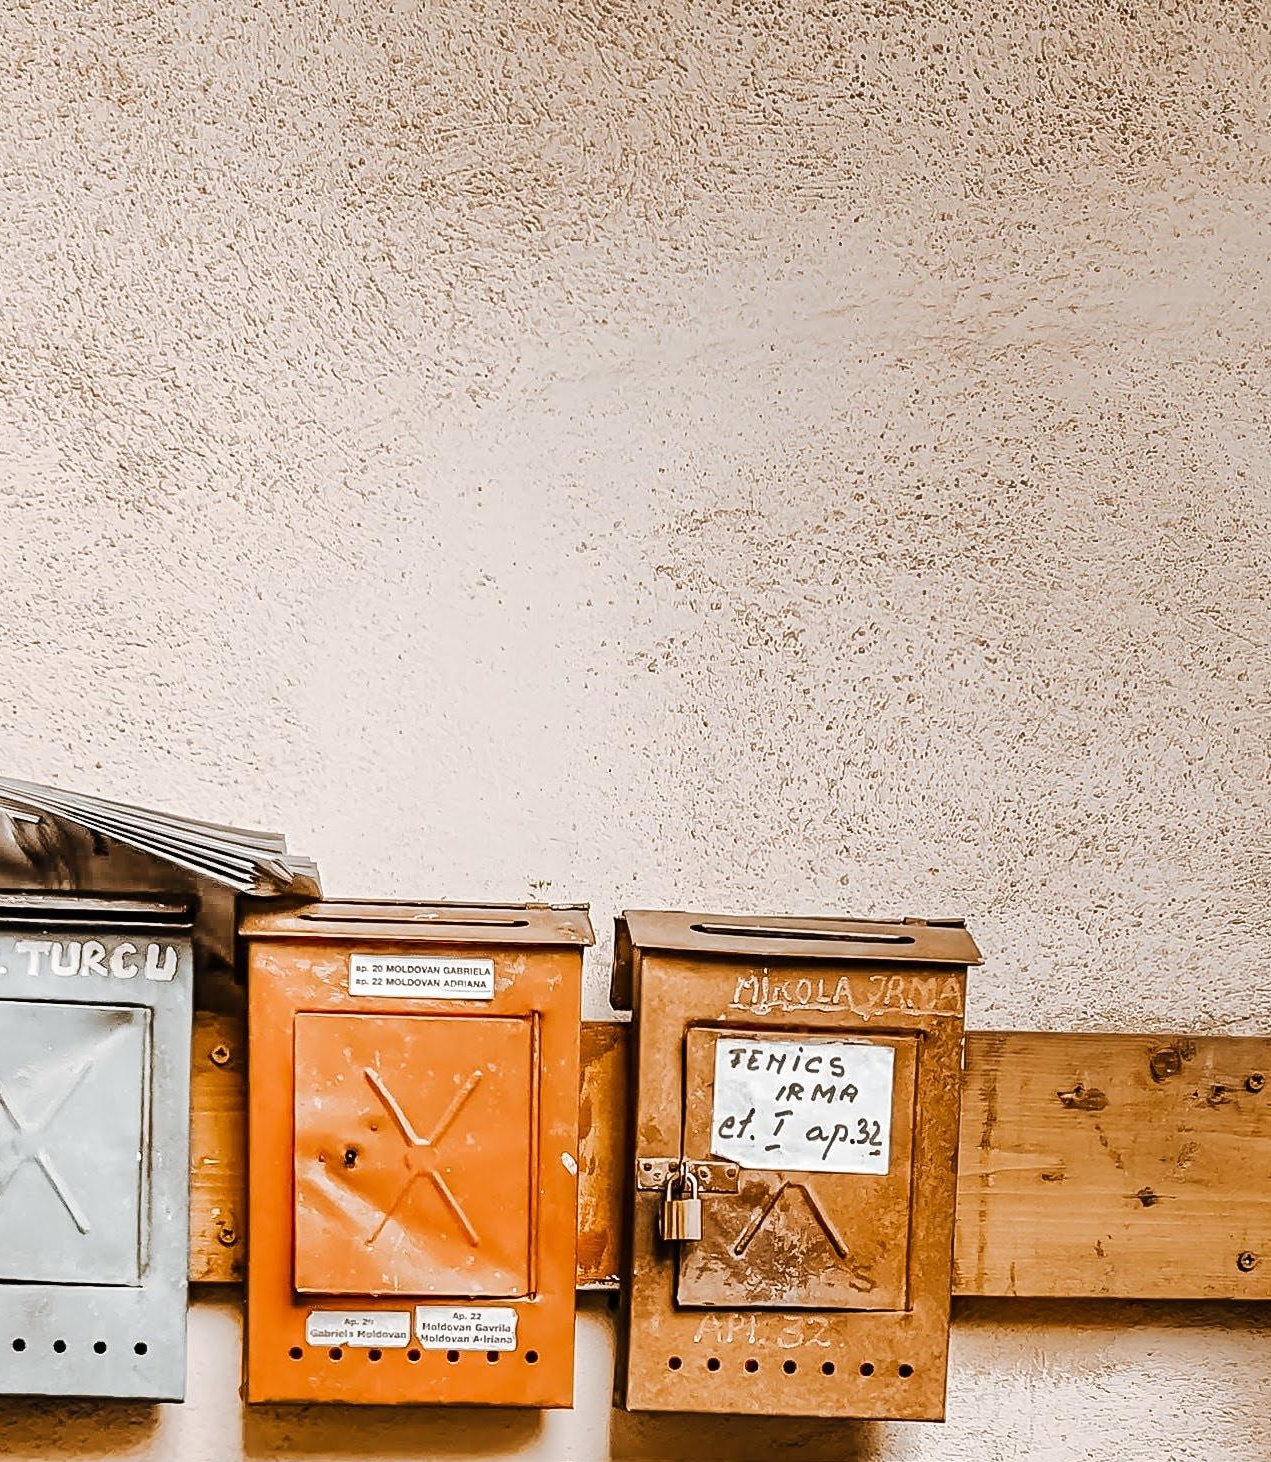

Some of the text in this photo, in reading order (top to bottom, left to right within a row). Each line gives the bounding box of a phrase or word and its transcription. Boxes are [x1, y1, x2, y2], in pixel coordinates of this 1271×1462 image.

[15, 939, 178, 981] TURCU
[372, 964, 383, 972] 20
[385, 964, 440, 975] MOLDOVAN
[443, 966, 491, 976] GABRIELA
[372, 977, 383, 986] 22
[385, 978, 440, 987] MOLDOVAN
[443, 979, 487, 989] ADRIANA
[775, 1083, 859, 1104] IRMA
[452, 1312, 482, 1321] Ap. 22
[422, 1323, 471, 1332] Moldovan
[357, 1330, 407, 1339] Moldovan
[420, 1335, 470, 1344] Moldovan
